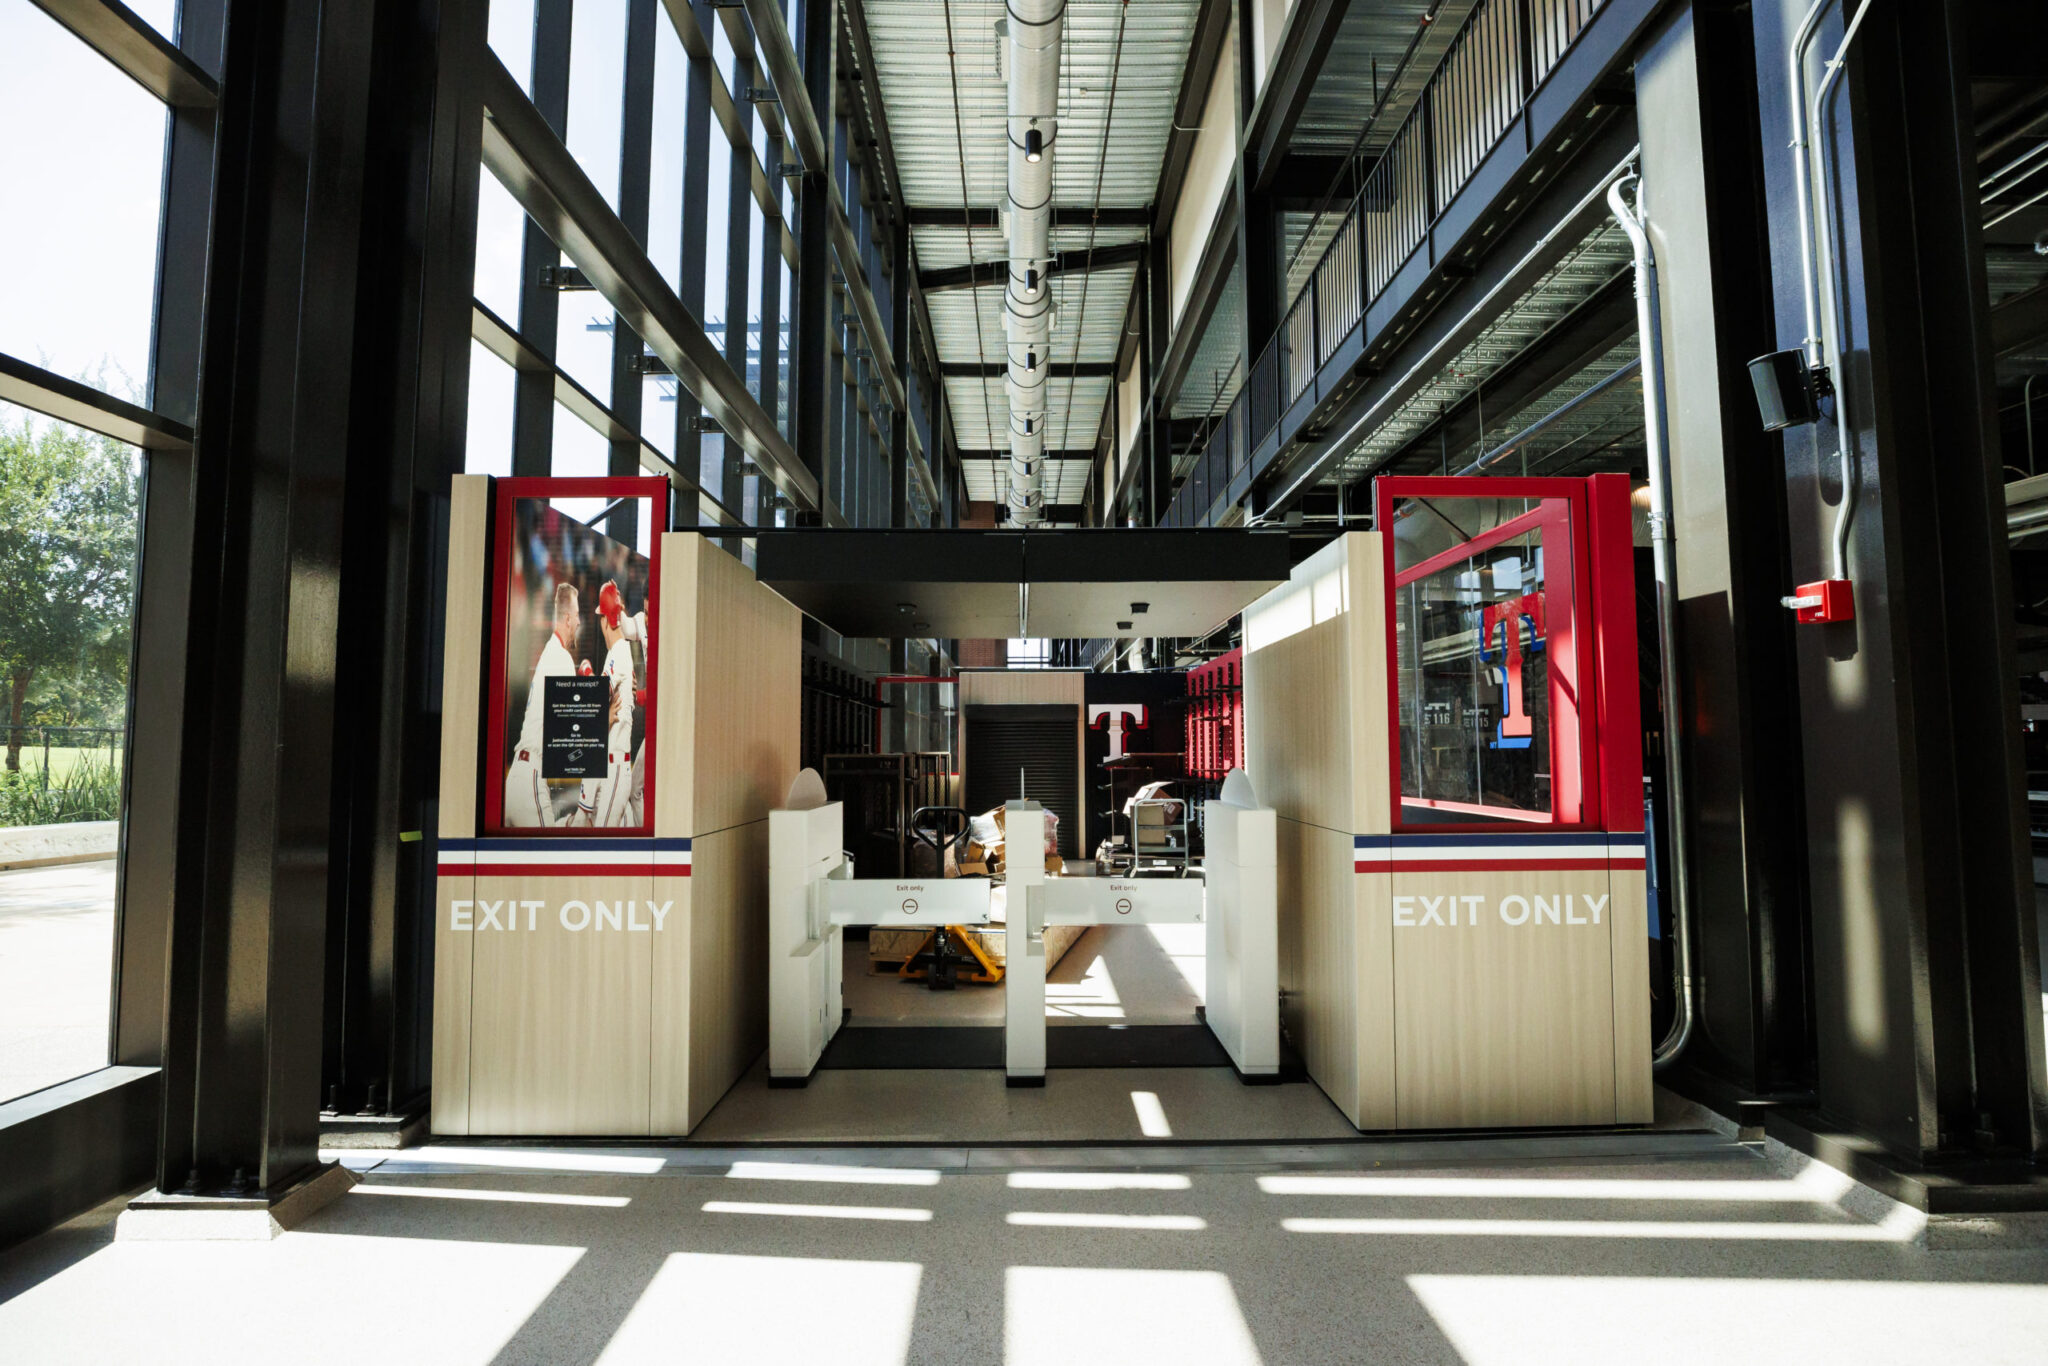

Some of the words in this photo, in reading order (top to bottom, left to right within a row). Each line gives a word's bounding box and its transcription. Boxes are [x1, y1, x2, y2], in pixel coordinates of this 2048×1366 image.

[1433, 713, 1450, 724] 116
[1088, 704, 1149, 765] T
[910, 884, 924, 893] only
[1123, 884, 1138, 893] only
[450, 900, 545, 931] EXIT
[559, 900, 674, 931] ONLY
[1392, 895, 1485, 927] EXIT
[1499, 894, 1609, 926] ONLY
